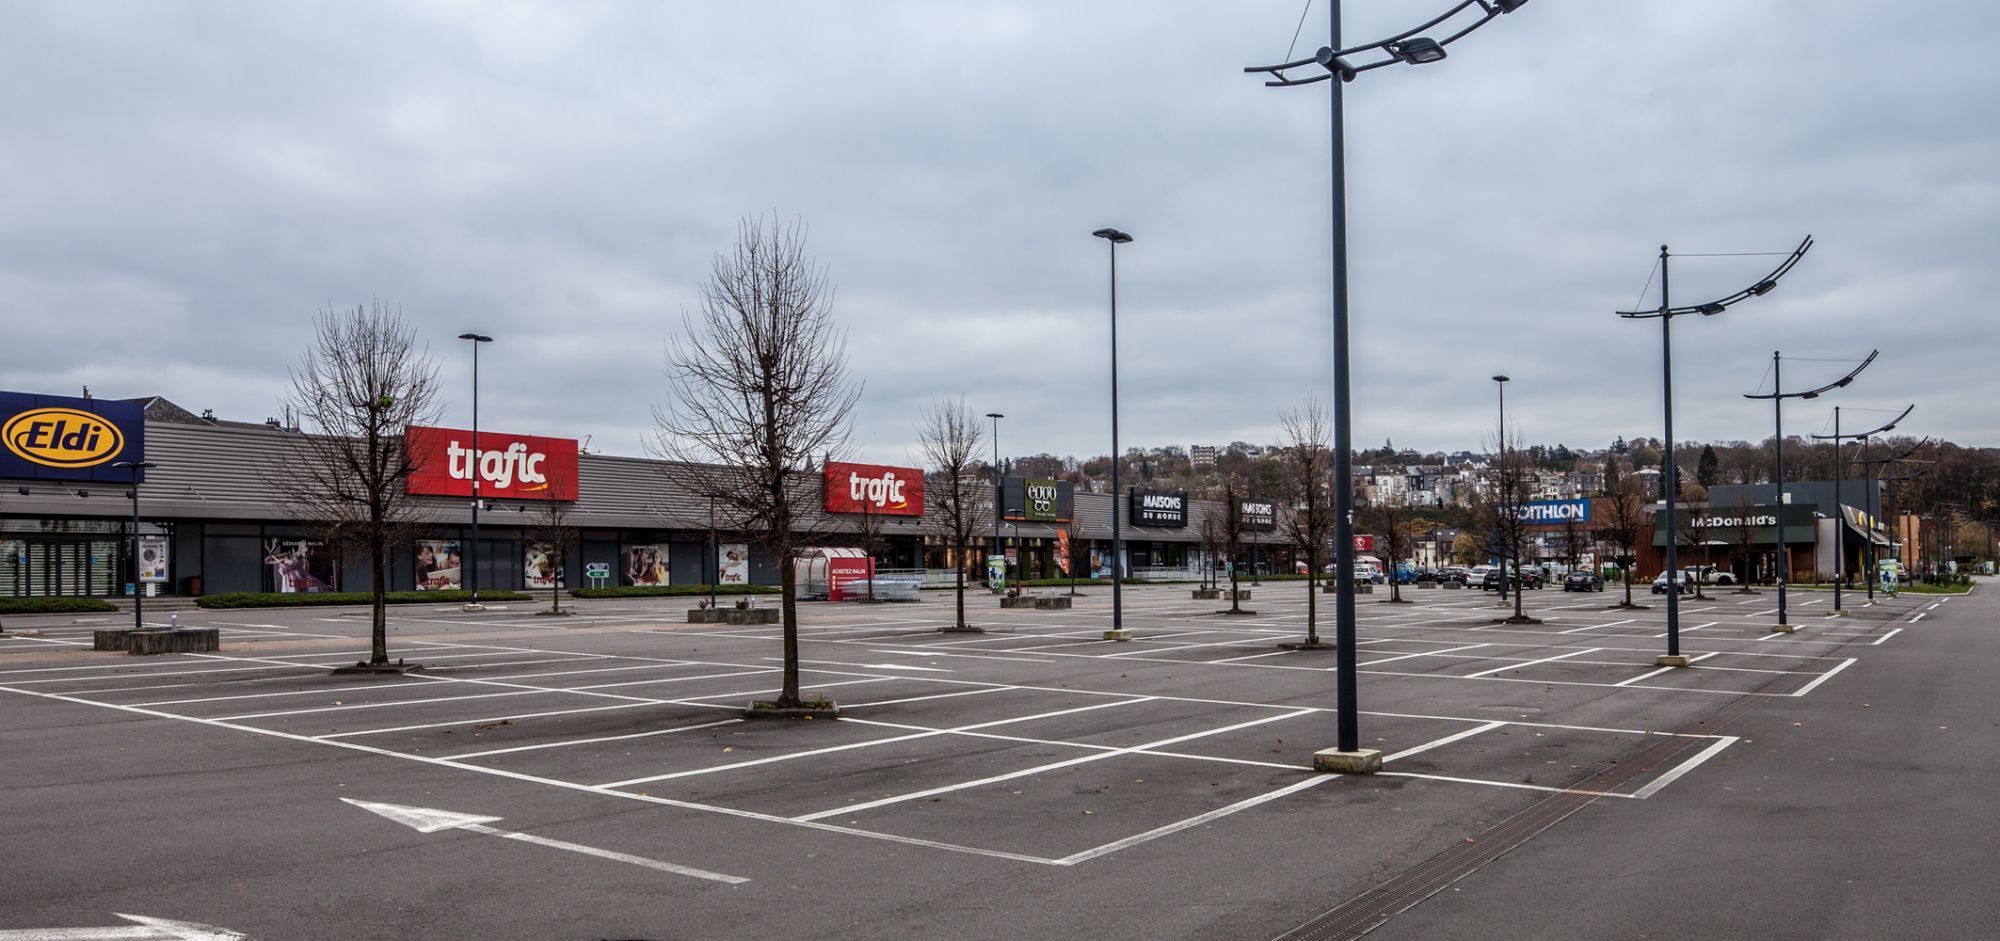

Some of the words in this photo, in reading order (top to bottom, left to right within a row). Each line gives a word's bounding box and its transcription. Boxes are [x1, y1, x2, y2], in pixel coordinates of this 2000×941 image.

[25, 420, 102, 452] Eldi
[447, 440, 546, 489] trafic
[850, 471, 906, 507] trafic
[1143, 495, 1181, 509] MAISONS
[1691, 515, 1776, 528] McDonald's
